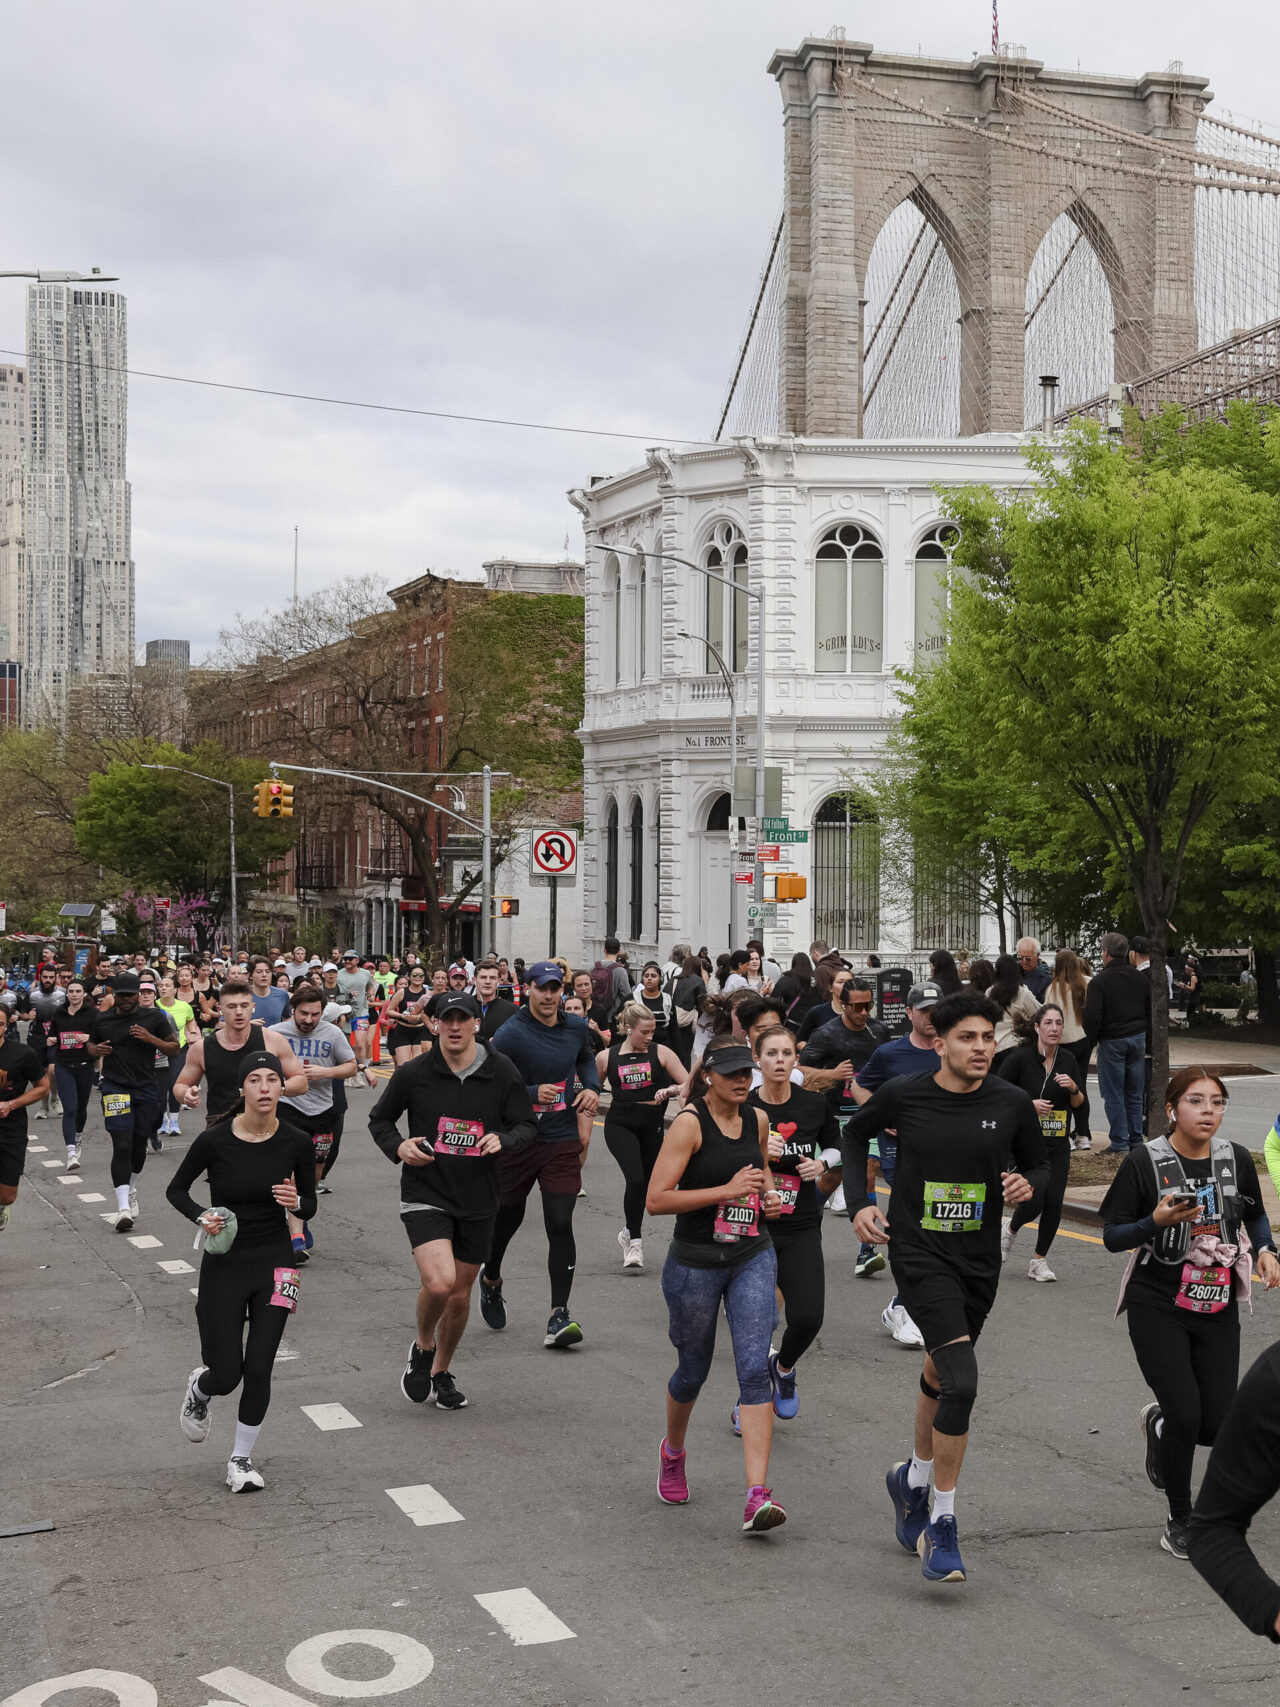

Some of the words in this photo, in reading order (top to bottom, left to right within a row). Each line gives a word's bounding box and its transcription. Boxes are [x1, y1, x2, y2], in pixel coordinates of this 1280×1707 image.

[825, 635, 875, 652] GRIMLDI'S
[704, 736, 732, 747] FRONT
[763, 818, 771, 829] Old
[771, 818, 785, 830] Fulton
[769, 831, 797, 841] Front
[798, 831, 805, 839] St
[288, 1039, 333, 1058] ARIS
[445, 1133, 475, 1146] 20710
[727, 1208, 754, 1223] 21017
[936, 1203, 972, 1218] 17216
[1188, 1284, 1221, 1300] 26071
